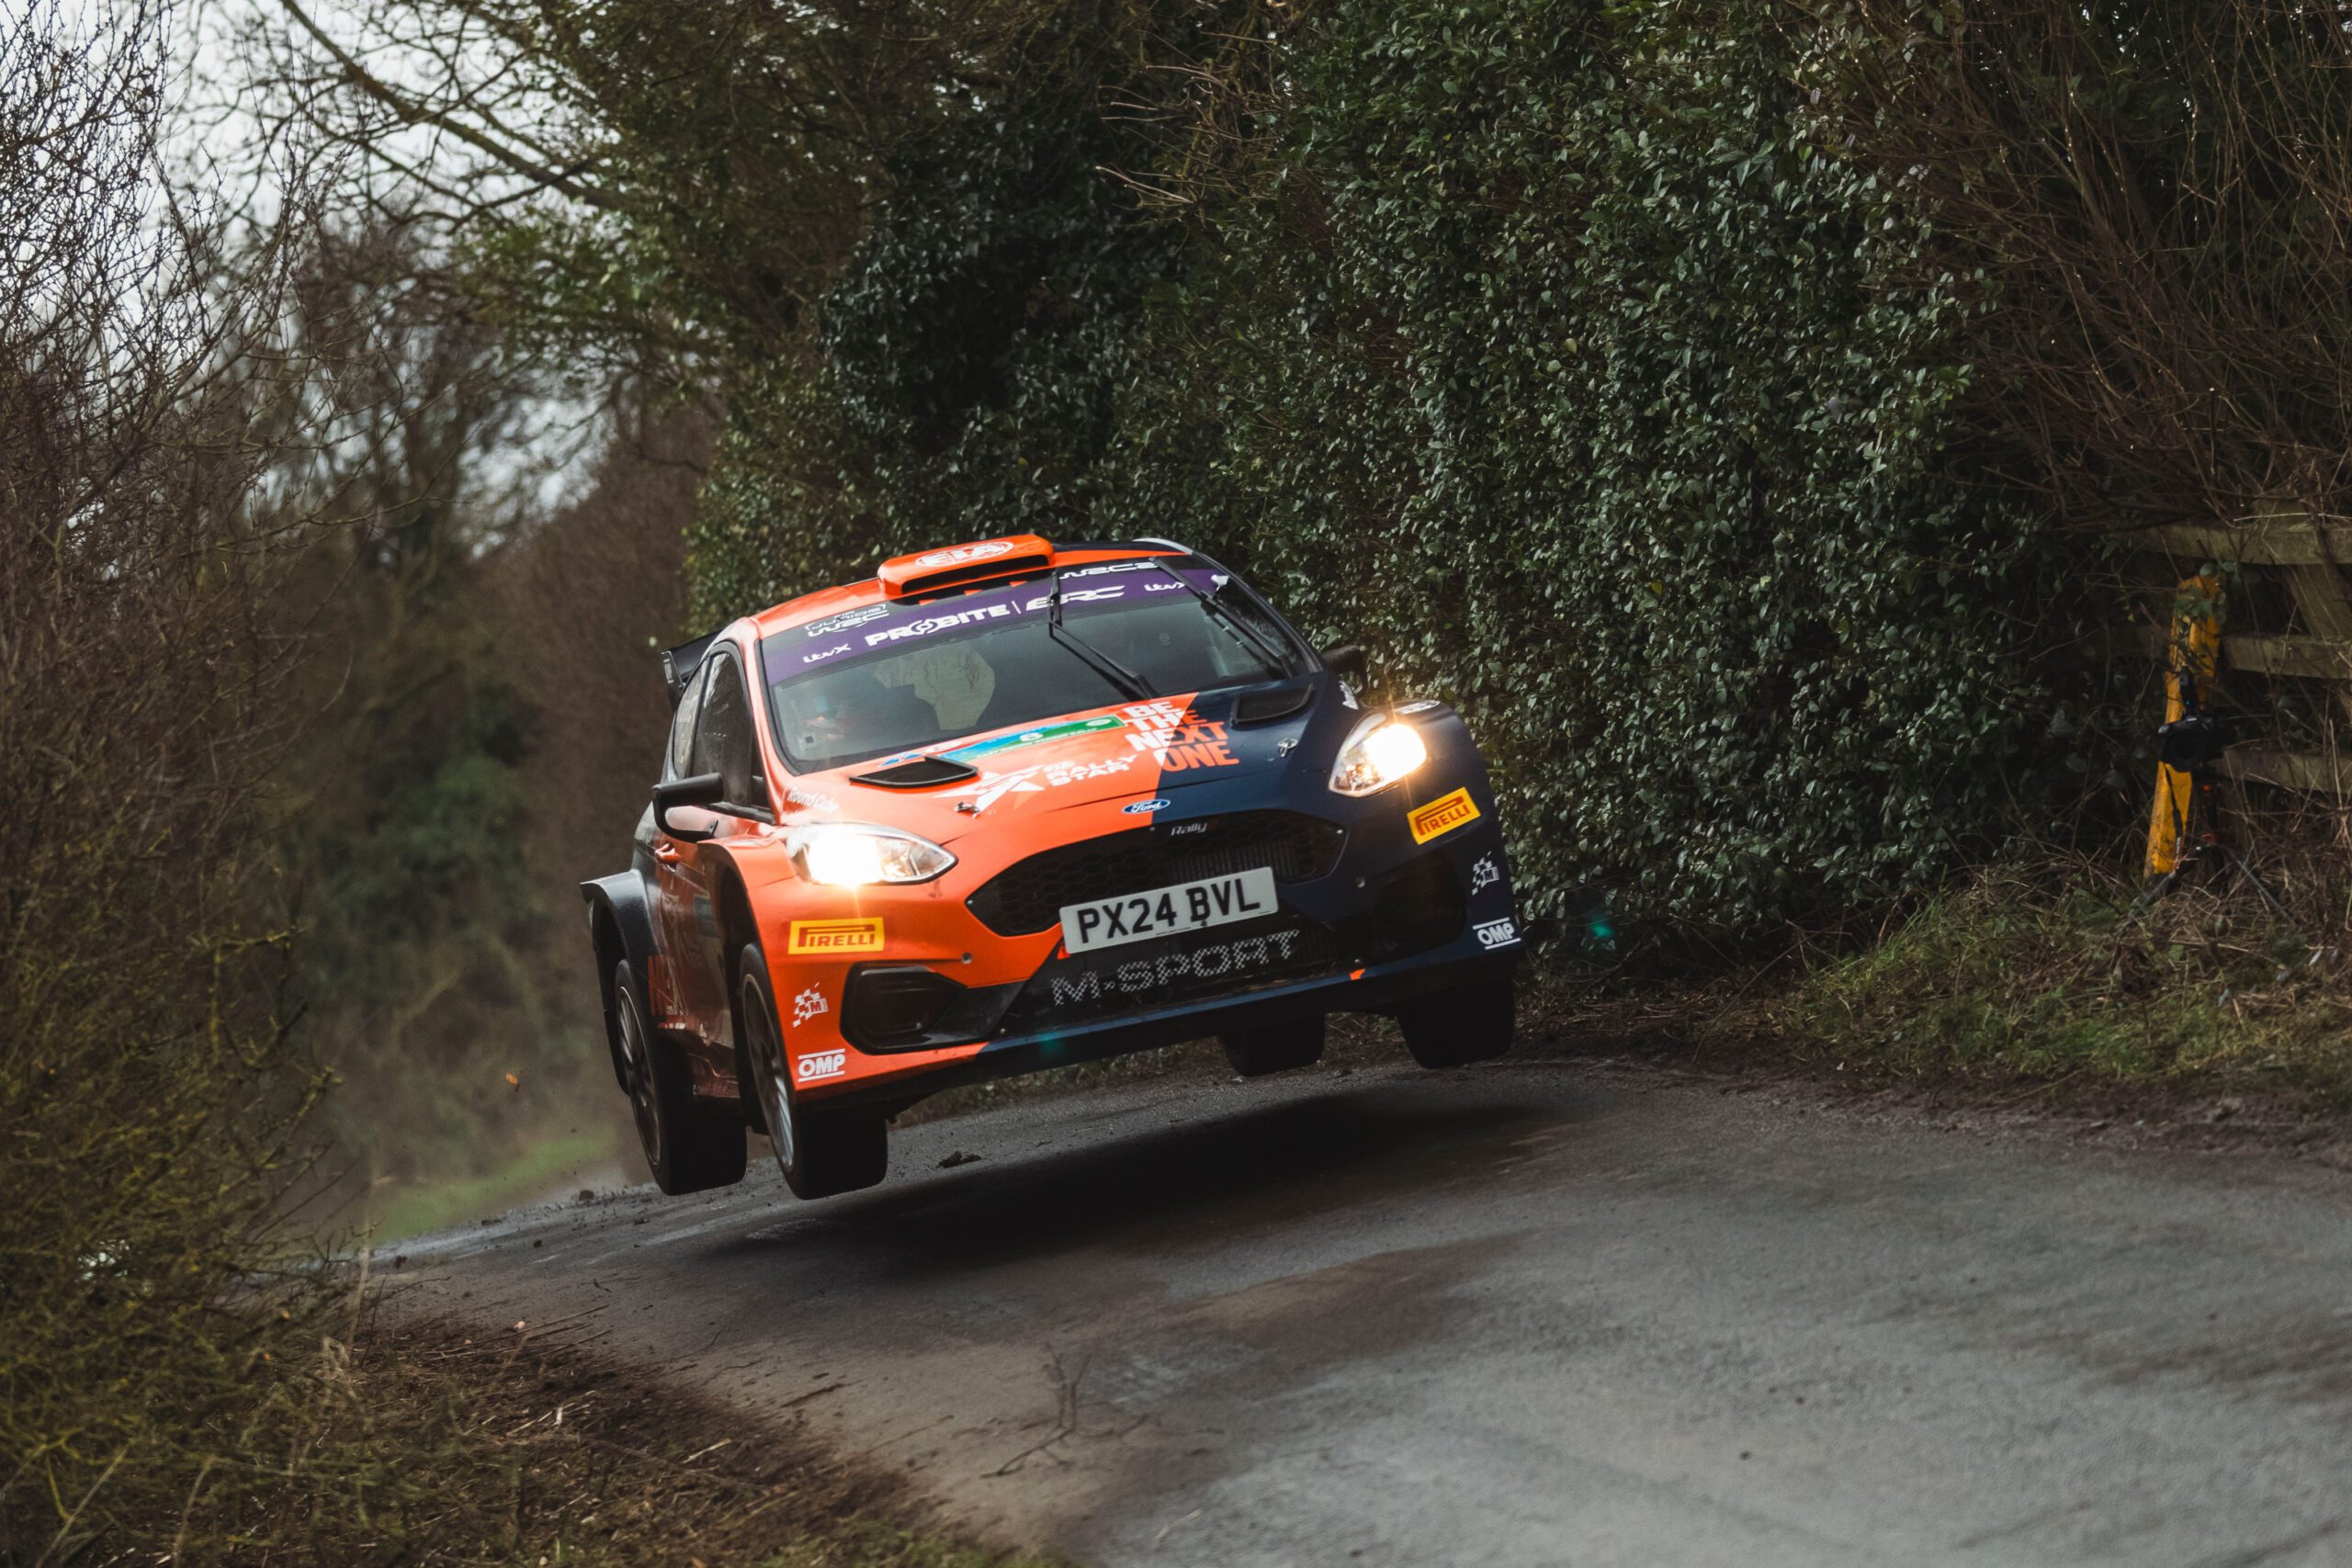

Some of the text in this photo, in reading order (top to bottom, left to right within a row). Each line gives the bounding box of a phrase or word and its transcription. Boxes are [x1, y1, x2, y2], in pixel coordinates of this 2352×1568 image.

[808, 610, 889, 637] WRC
[865, 604, 1010, 647] PROBITE
[1123, 701, 1182, 717] BE
[1125, 710, 1207, 731] THE
[1125, 721, 1228, 751] NEXT
[1046, 754, 1138, 780] RALLY
[1153, 740, 1239, 772] ONE
[1050, 763, 1130, 786] STAR
[1130, 800, 1163, 814] Ford
[1414, 795, 1471, 837] PIRELLI
[1077, 876, 1261, 944] PX24 BVL
[797, 924, 876, 948] PIRELLI
[1477, 922, 1515, 945] OMP
[798, 1054, 846, 1077] OMP
